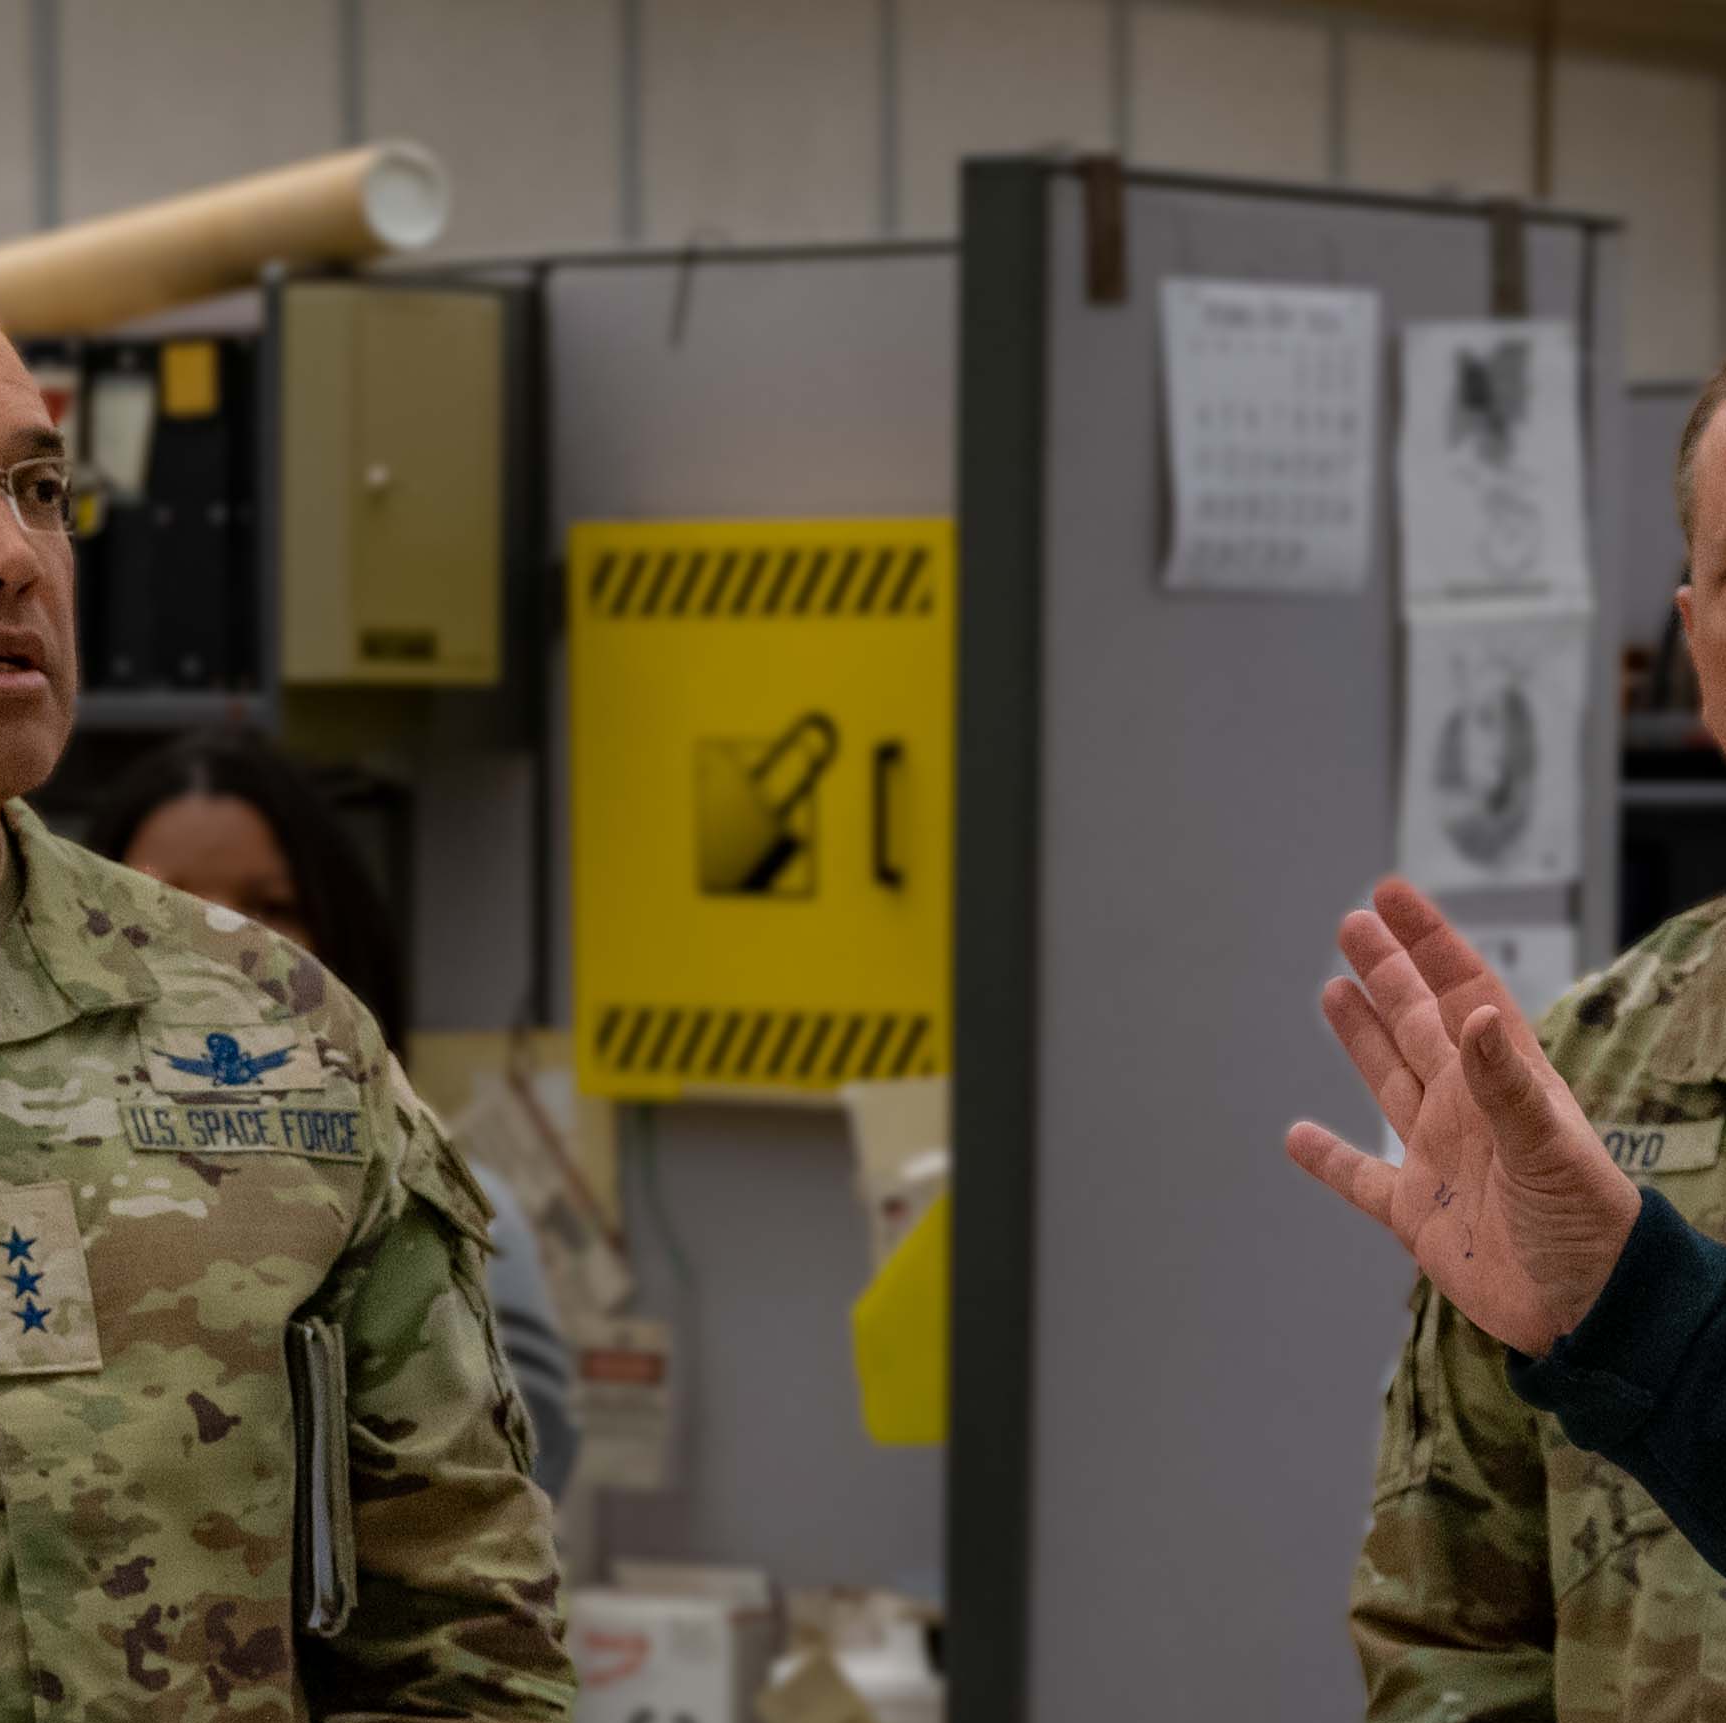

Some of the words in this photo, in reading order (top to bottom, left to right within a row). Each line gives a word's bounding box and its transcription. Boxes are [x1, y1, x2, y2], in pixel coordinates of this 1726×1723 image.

[130, 1106, 184, 1147] U.S.
[186, 1107, 275, 1148] SPACE
[278, 1107, 361, 1154] FORCE
